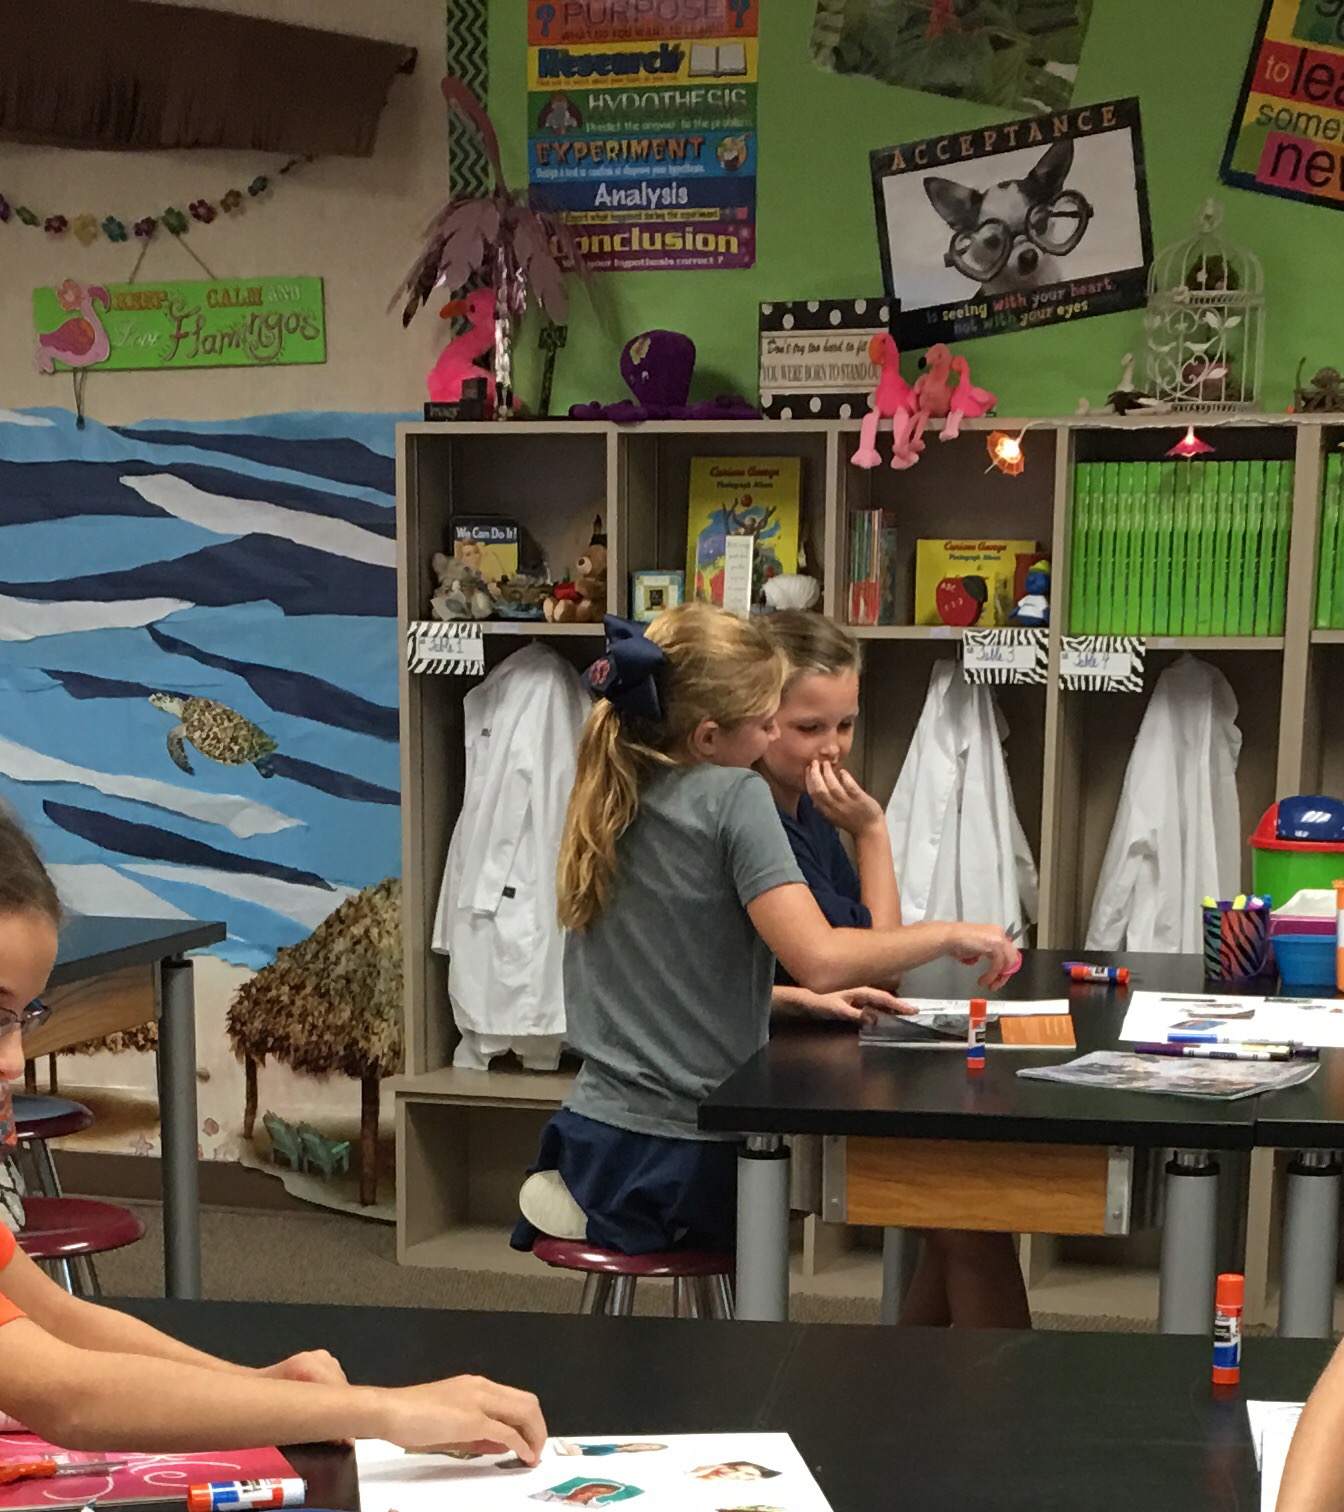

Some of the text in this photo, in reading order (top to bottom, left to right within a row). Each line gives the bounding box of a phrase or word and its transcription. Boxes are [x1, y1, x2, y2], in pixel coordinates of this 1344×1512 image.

[562, 0, 725, 27] PURPOSE
[1264, 55, 1290, 82] to
[536, 137, 704, 165] EXPERIMENT
[891, 105, 1115, 170] ACCEPTANCE
[594, 181, 688, 209] Analysis
[206, 287, 263, 308] CALM
[268, 284, 301, 302] AND
[943, 303, 987, 321] seeing
[993, 295, 1027, 311] with
[1031, 289, 1065, 308] your
[162, 297, 321, 362] Flamingos
[954, 318, 978, 334] not
[983, 312, 1017, 329] with
[1019, 307, 1053, 326] your
[767, 337, 791, 354] Don't
[793, 342, 806, 356] try
[808, 341, 821, 353] too
[823, 338, 844, 352] hard
[762, 362, 880, 382] YOU WERE BORN TO STAND OU
[456, 526, 471, 538] We
[472, 526, 490, 539] Can
[491, 526, 505, 539] Do
[976, 645, 1015, 663] Table 3
[1074, 652, 1110, 670] Table 4
